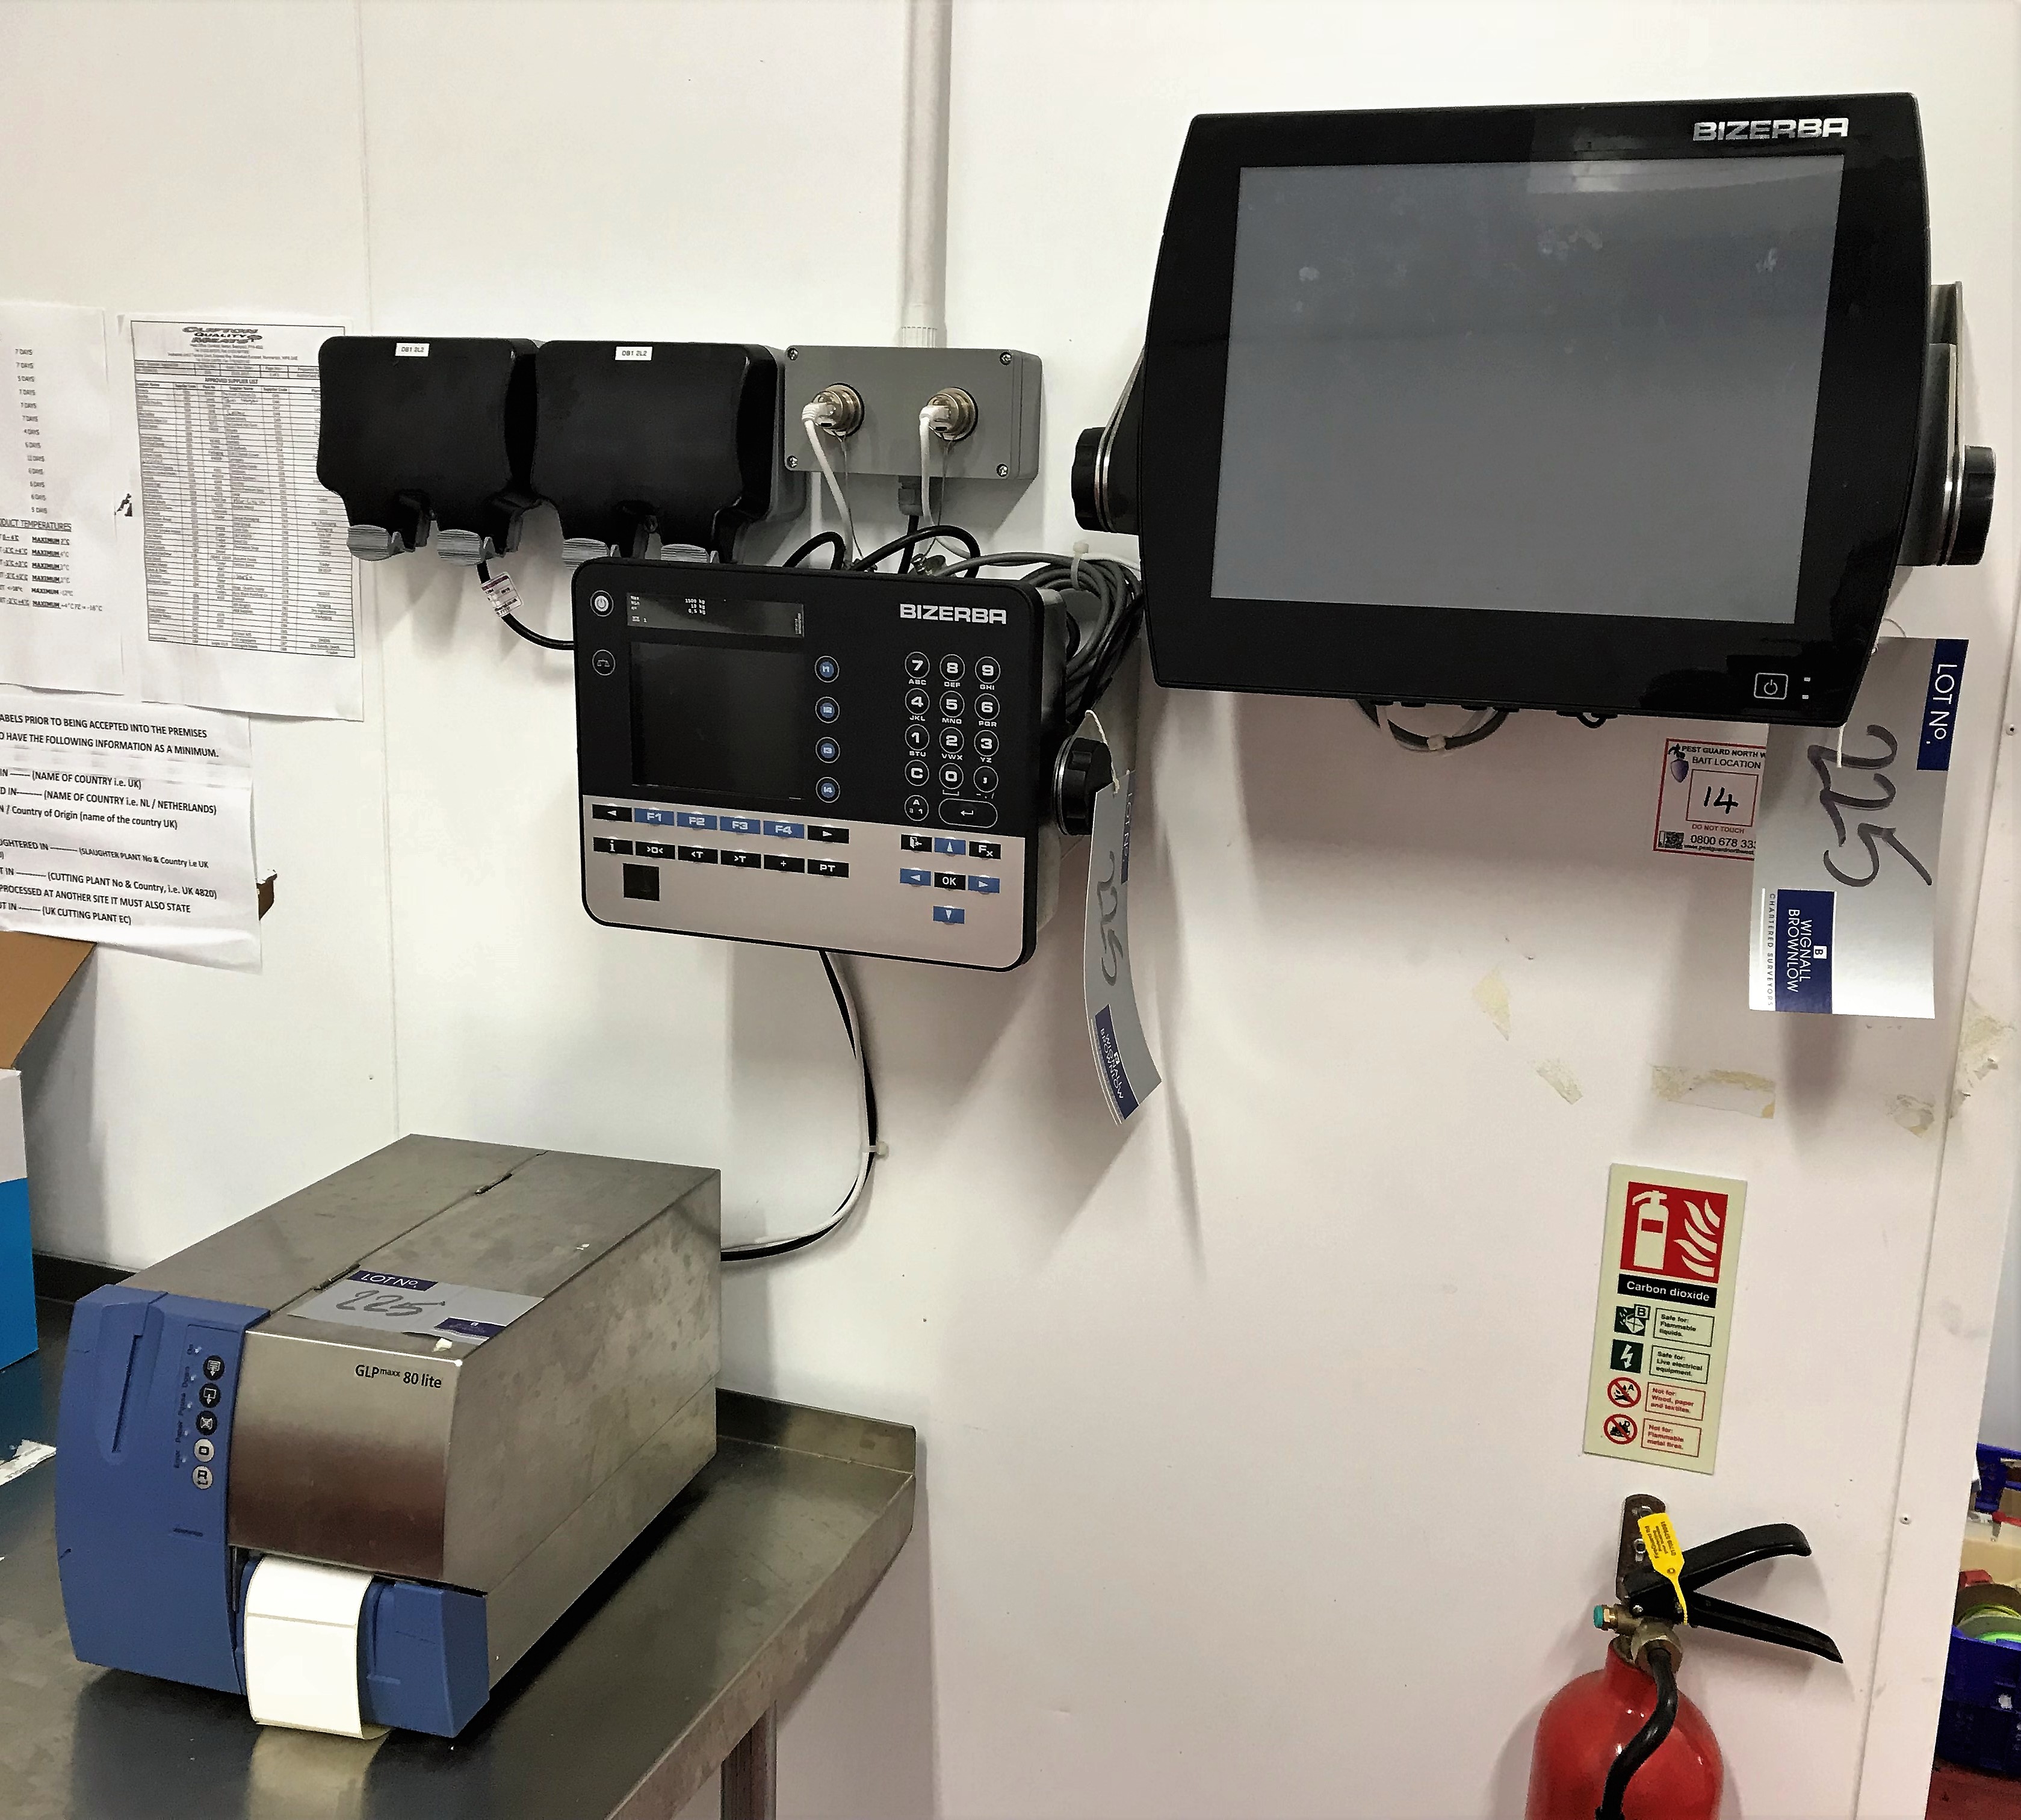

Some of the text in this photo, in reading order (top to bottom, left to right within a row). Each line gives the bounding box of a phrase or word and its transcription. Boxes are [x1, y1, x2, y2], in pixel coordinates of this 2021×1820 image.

[1692, 117, 1849, 141] BIZERBA
[20, 519, 72, 530] TEMPERATURES
[900, 603, 1007, 625] BIZERBA
[912, 660, 994, 676] 7 8 9
[1933, 664, 1958, 705] LOT
[911, 696, 993, 713] 4 5 6
[25, 716, 49, 725] PRIOR
[51, 717, 62, 726] TO
[64, 719, 87, 728] BEING
[90, 721, 129, 731] ACCEPTED
[130, 724, 150, 733] INTO
[150, 725, 167, 734] THE
[169, 727, 207, 738] PREMISES
[6, 732, 28, 741] HAVE
[29, 734, 44, 743] THE
[46, 735, 93, 747] FOLLOWING
[95, 739, 152, 752] INFORMATION
[175, 746, 219, 758] MINIMUM.
[911, 732, 992, 749] 1 2 3
[1702, 747, 1730, 755] GUARD
[1692, 756, 1762, 769] BAIT LOCATION
[32, 770, 141, 790] (NAME OF COUNTRY i.e. UK)
[911, 767, 923, 779] C
[44, 790, 217, 816] (NAME OF COUNTRY i.e. NL NETHERLANDS)
[1703, 786, 1739, 814] 14
[1807, 724, 1933, 887] 225
[12, 806, 178, 831] Country of Origin (name of the country UK)
[646, 811, 793, 835] F1 F2 F3 F4
[1690, 834, 1716, 845] 0800
[1718, 837, 1738, 847] 678
[40, 843, 49, 851] IN
[79, 847, 119, 859] (SLAUGHTER
[120, 852, 141, 861] PLANT
[160, 857, 187, 867] Country
[820, 863, 836, 873] PT
[5, 867, 217, 900] IN (CUTTING PLANT No Country, i.e. UK 4820)
[942, 876, 957, 886] OK
[44, 889, 54, 897] AT
[55, 891, 91, 902] ANOTHER
[93, 894, 110, 904] SITE
[111, 896, 118, 905] IT
[120, 897, 143, 908] MUST
[144, 900, 166, 910] ALSO
[167, 903, 191, 913] STATE
[42, 906, 57, 916] (UK
[57, 908, 91, 920] CUTTING
[93, 912, 117, 923] PLANT
[119, 915, 132, 926] EC)
[1767, 893, 1776, 948] CHARTERED
[1786, 908, 1800, 992] BROWNLOW
[1799, 919, 1813, 983] WIGNALL
[361, 1273, 393, 1284] LOT
[1627, 1281, 1710, 1301] Carbon dioxide
[1637, 1307, 1646, 1316] B
[1660, 1321, 1697, 1332] Flammable
[1656, 1366, 1692, 1376] equipment.
[1672, 1361, 1703, 1371] electrical
[403, 1372, 419, 1385] 80
[421, 1373, 442, 1389] lite
[1648, 1431, 1684, 1442] Flammable
